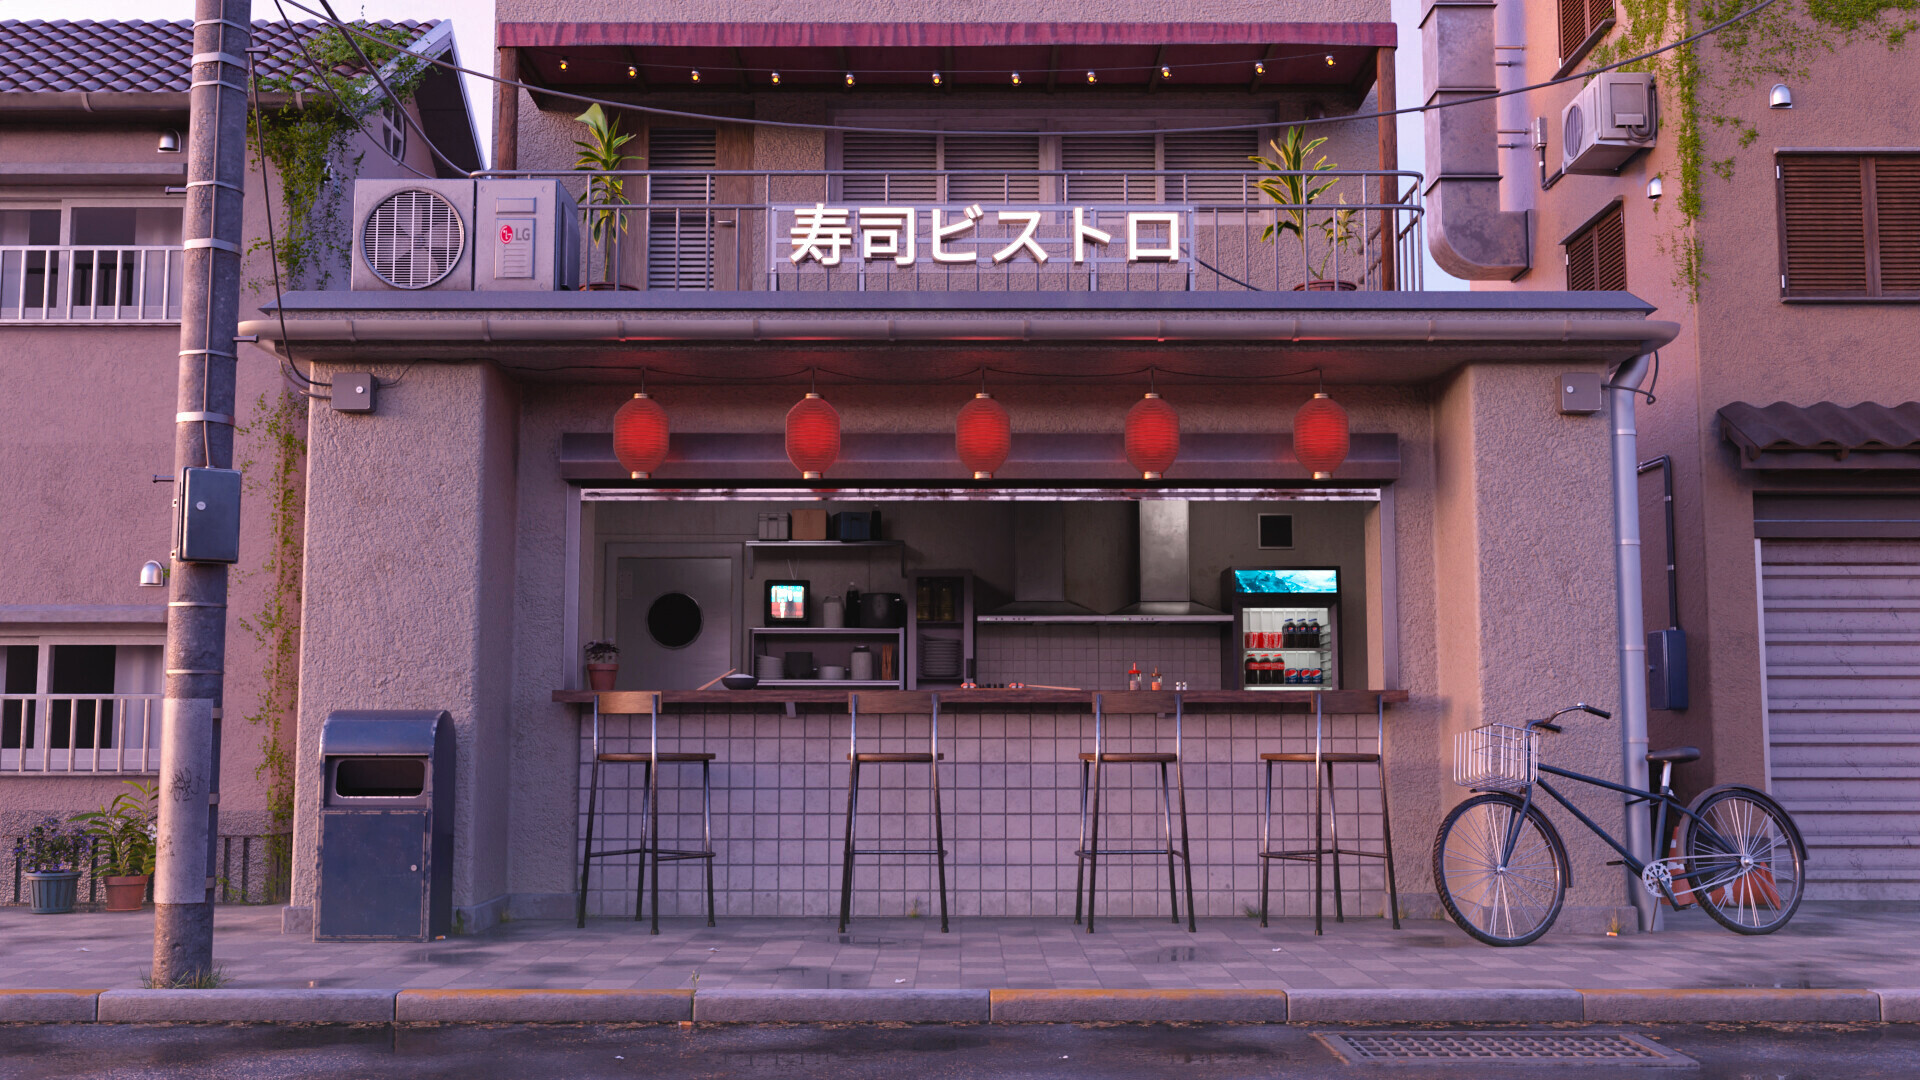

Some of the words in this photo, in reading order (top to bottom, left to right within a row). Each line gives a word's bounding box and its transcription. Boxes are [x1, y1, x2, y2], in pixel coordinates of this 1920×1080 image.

[515, 227, 531, 241] LG
[790, 203, 1180, 266] 寿司ビストロ
